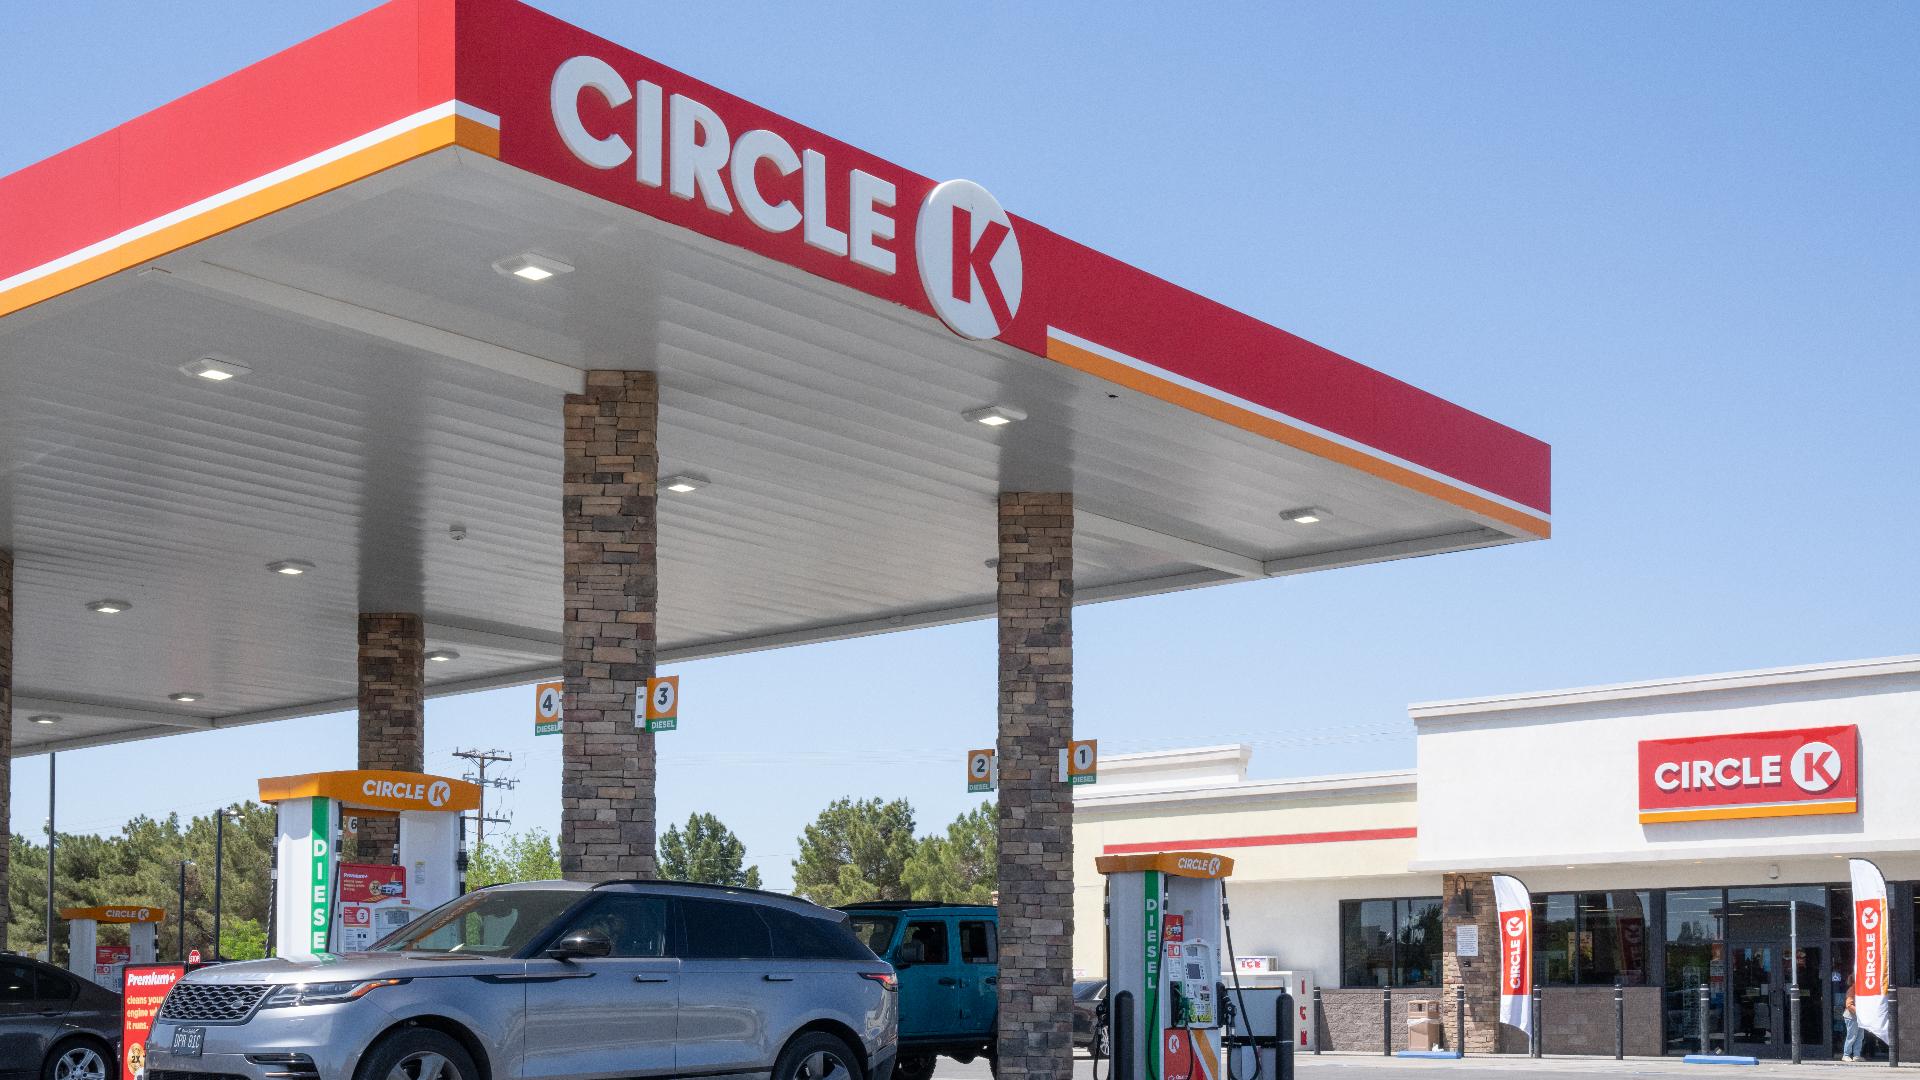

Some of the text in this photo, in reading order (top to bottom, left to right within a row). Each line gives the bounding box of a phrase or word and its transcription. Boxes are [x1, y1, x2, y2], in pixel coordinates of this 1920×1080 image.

[550, 55, 897, 275] CIRCLE
[542, 694, 553, 712] 4
[657, 687, 669, 706] 3
[536, 722, 559, 733] DIESEL
[651, 719, 675, 729] DIESEL
[1079, 749, 1086, 764] 1
[976, 758, 985, 773] 2
[1654, 755, 1781, 790] CIRCLE
[1072, 775, 1094, 783] DIESEL
[362, 779, 425, 800] CIRCLE
[968, 783, 989, 791] DIESEL
[1178, 857, 1209, 871] CIRCLE
[313, 839, 328, 950] DIESE
[105, 909, 136, 918] CIRCLE
[1146, 898, 1158, 990] DIESEL
[189, 955, 200, 964] STOP
[1241, 960, 1261, 969] ICE
[1509, 939, 1521, 989] CIRCLE
[1865, 932, 1876, 989] CIRCLE
[127, 971, 175, 986] Premium+
[127, 995, 147, 1005] cleans
[127, 1008, 148, 1019] engine
[1299, 975, 1307, 1046] ICE
[126, 1020, 149, 1030] it runs.
[131, 1055, 141, 1064] 2X
